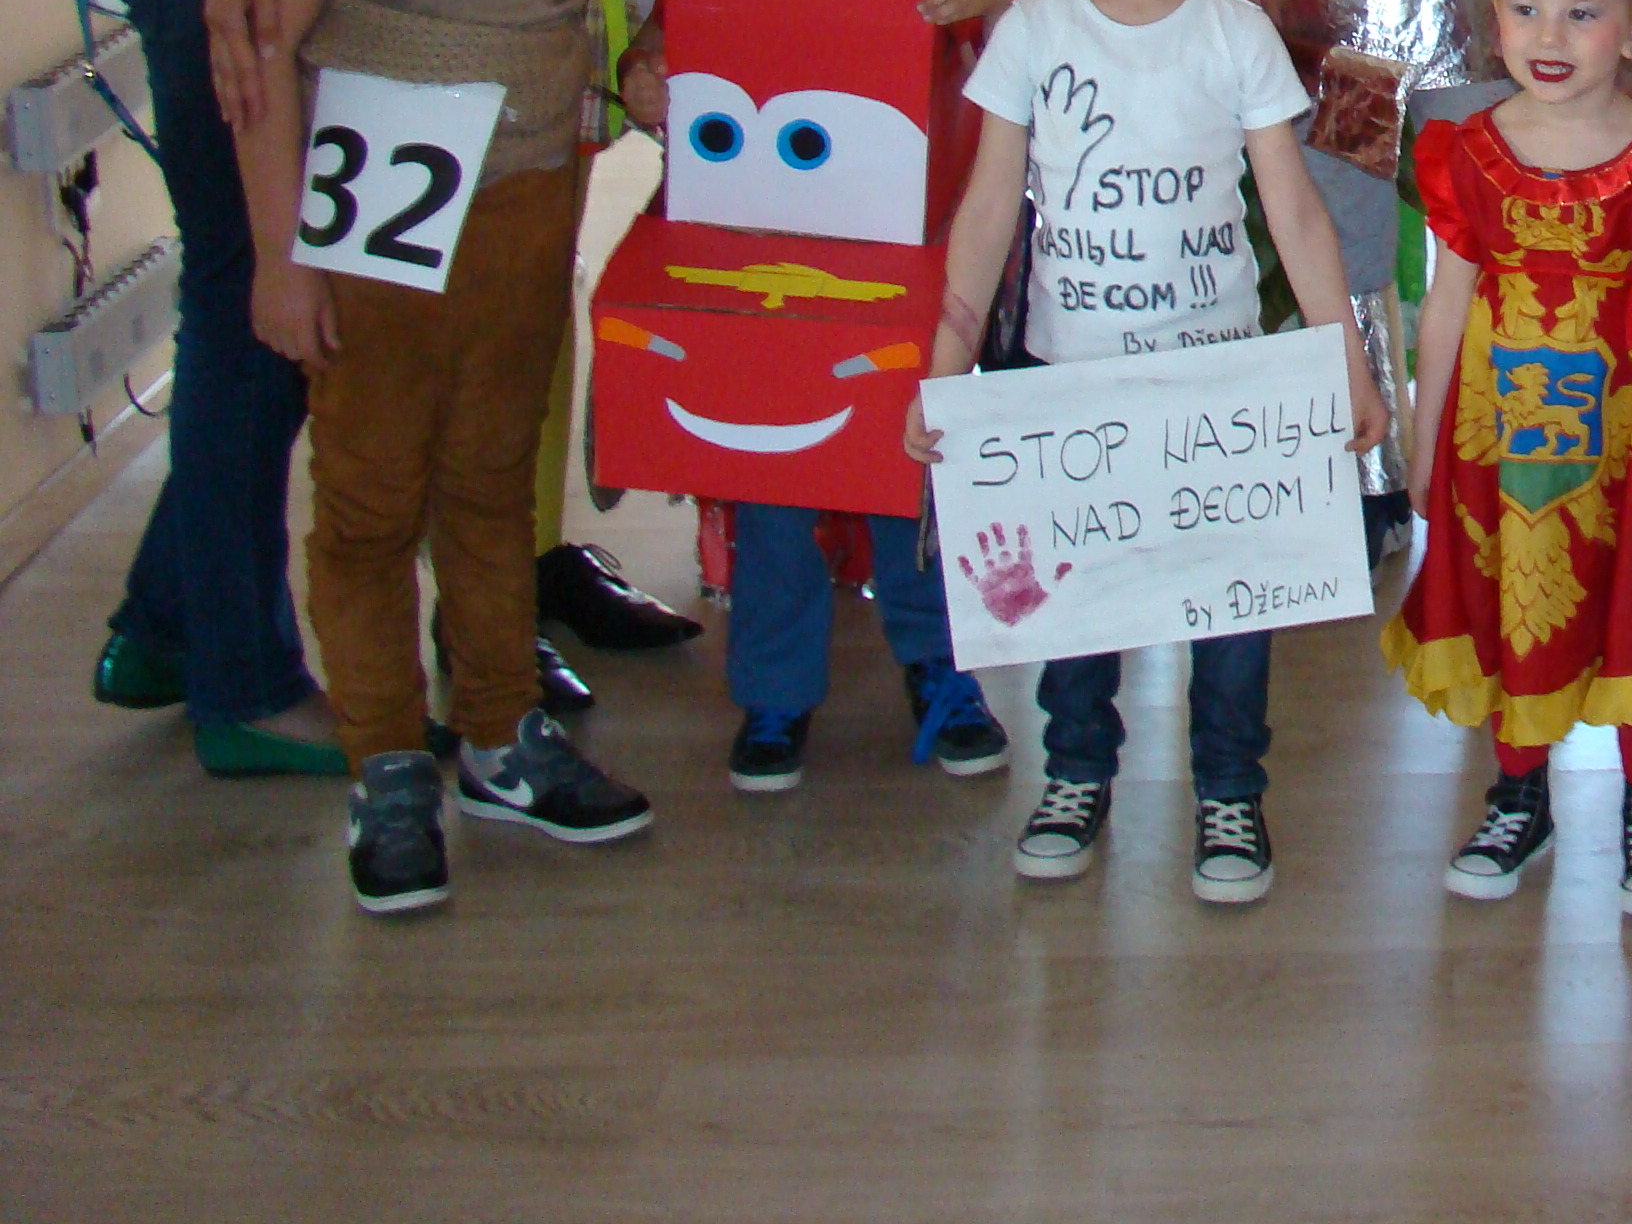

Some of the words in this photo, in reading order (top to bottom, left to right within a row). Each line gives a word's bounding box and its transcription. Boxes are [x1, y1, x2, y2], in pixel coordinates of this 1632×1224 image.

[299, 125, 463, 269] 32
[1093, 165, 1205, 212] STOP
[1180, 221, 1235, 260] NAD
[971, 421, 1129, 488] STOP
[1050, 501, 1142, 550] NAD
